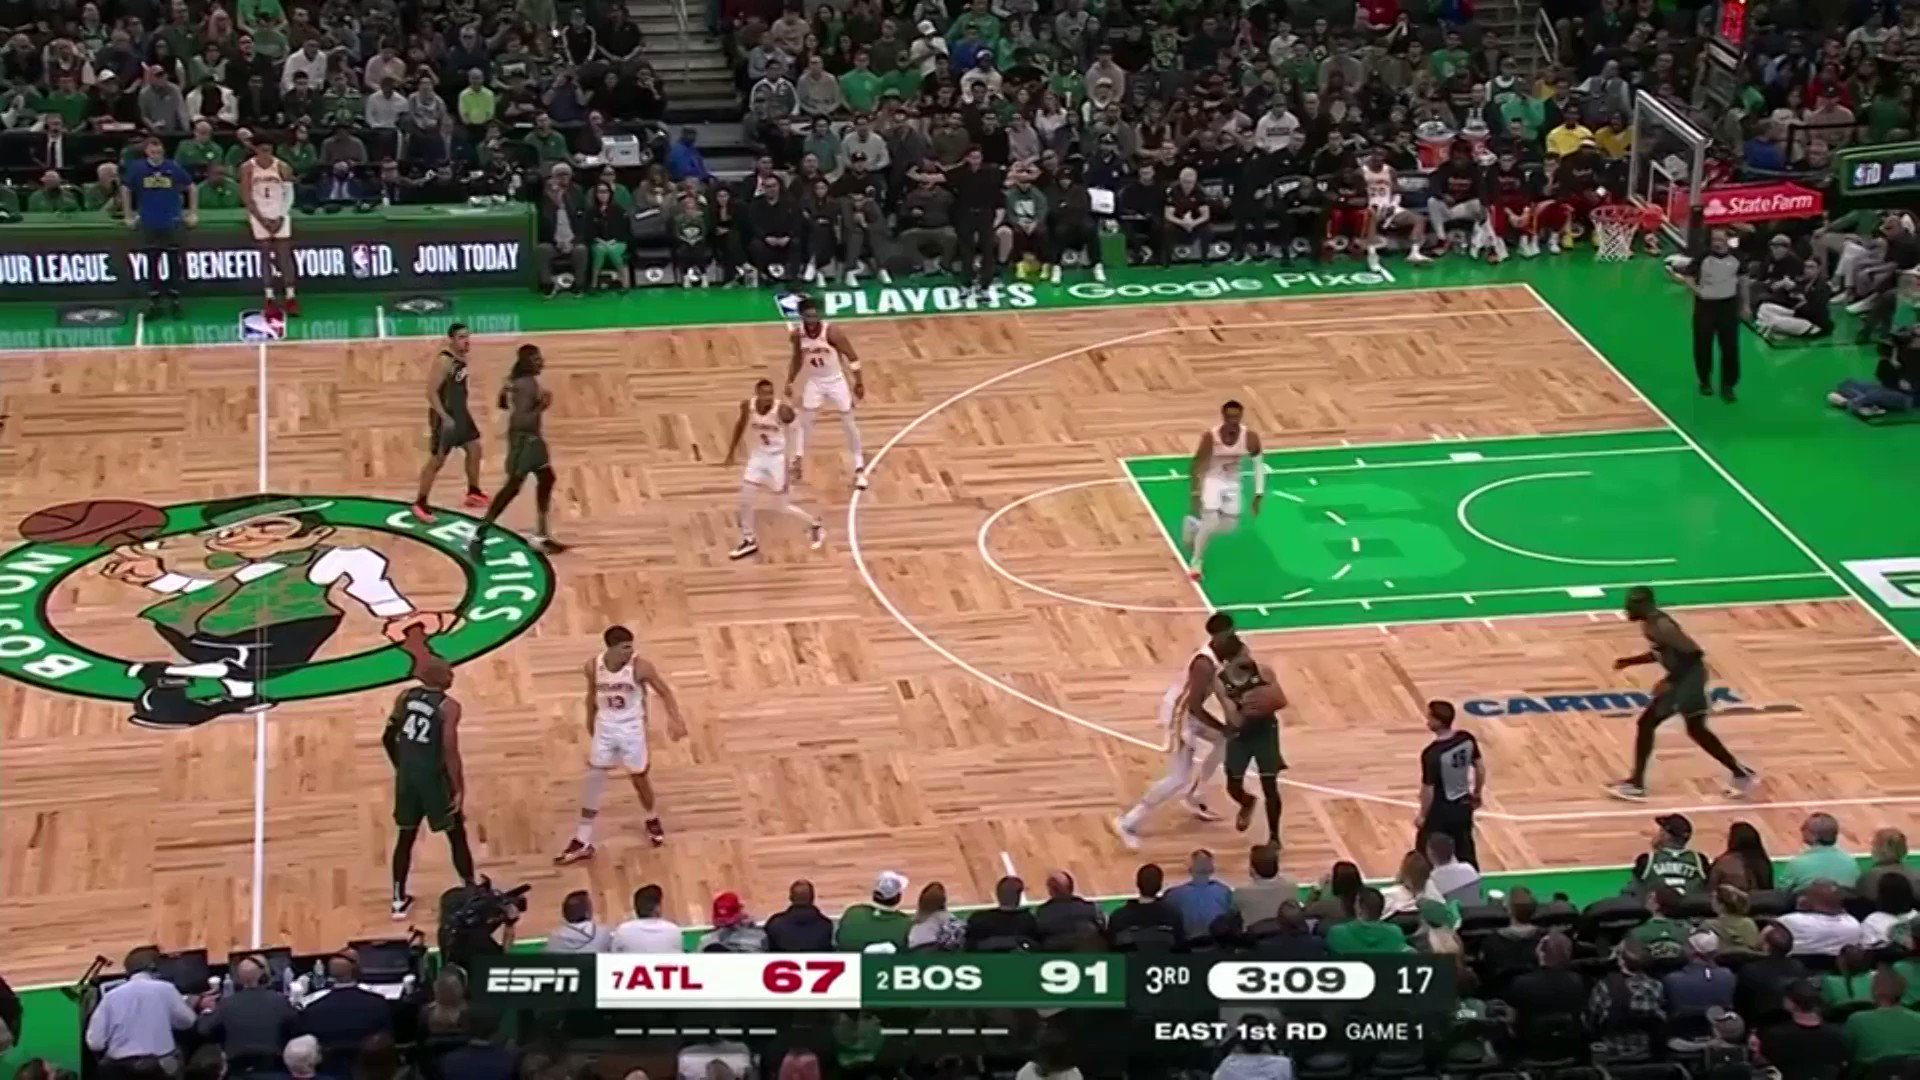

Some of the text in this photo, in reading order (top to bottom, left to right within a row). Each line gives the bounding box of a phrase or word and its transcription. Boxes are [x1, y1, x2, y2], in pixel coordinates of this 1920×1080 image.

[35, 253, 117, 283] LEAGUE.
[293, 248, 346, 277] YOUR
[413, 245, 458, 274] JOIN
[459, 243, 520, 272] TODAY
[1067, 264, 1397, 298] Google Pixel
[607, 695, 626, 710] 13
[1463, 687, 1743, 717] CARMX
[402, 713, 431, 743] 42
